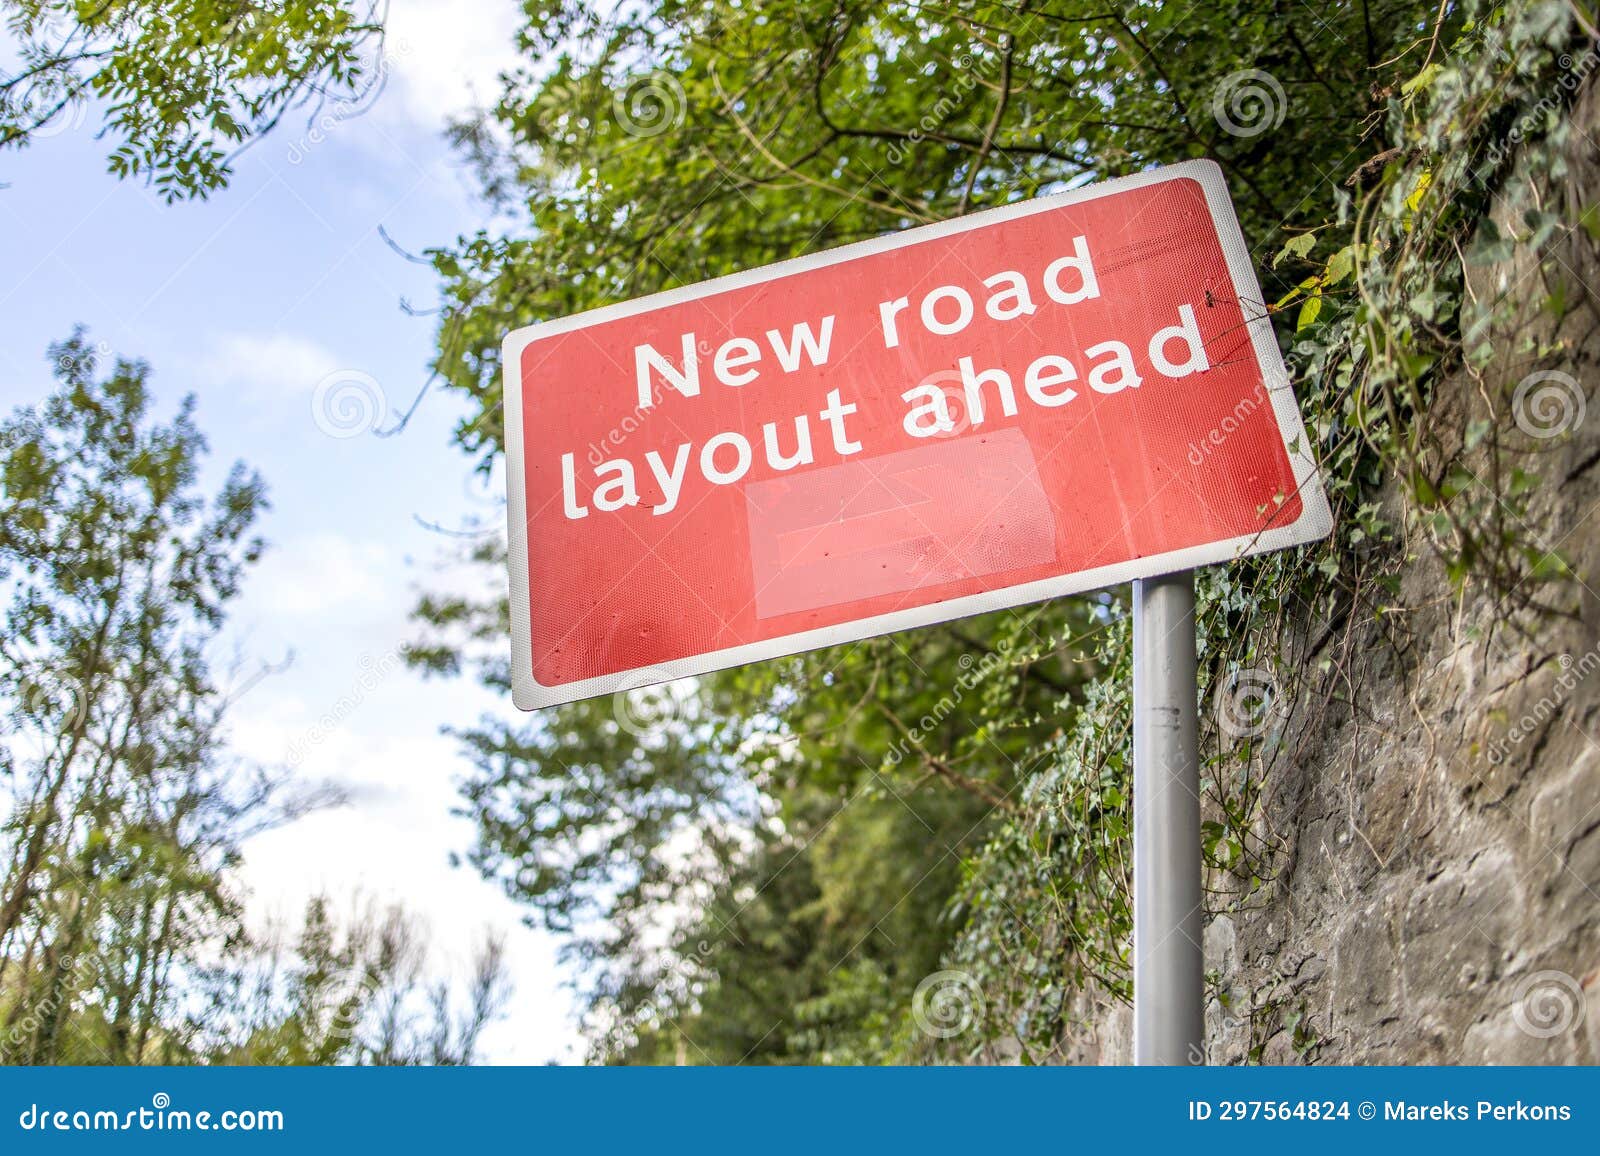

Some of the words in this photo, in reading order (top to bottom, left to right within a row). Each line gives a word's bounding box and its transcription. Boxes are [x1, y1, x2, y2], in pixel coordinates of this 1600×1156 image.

[561, 387, 864, 520] layout
[900, 304, 1211, 439] ahead
[633, 314, 836, 411] New
[878, 235, 1101, 349] road
